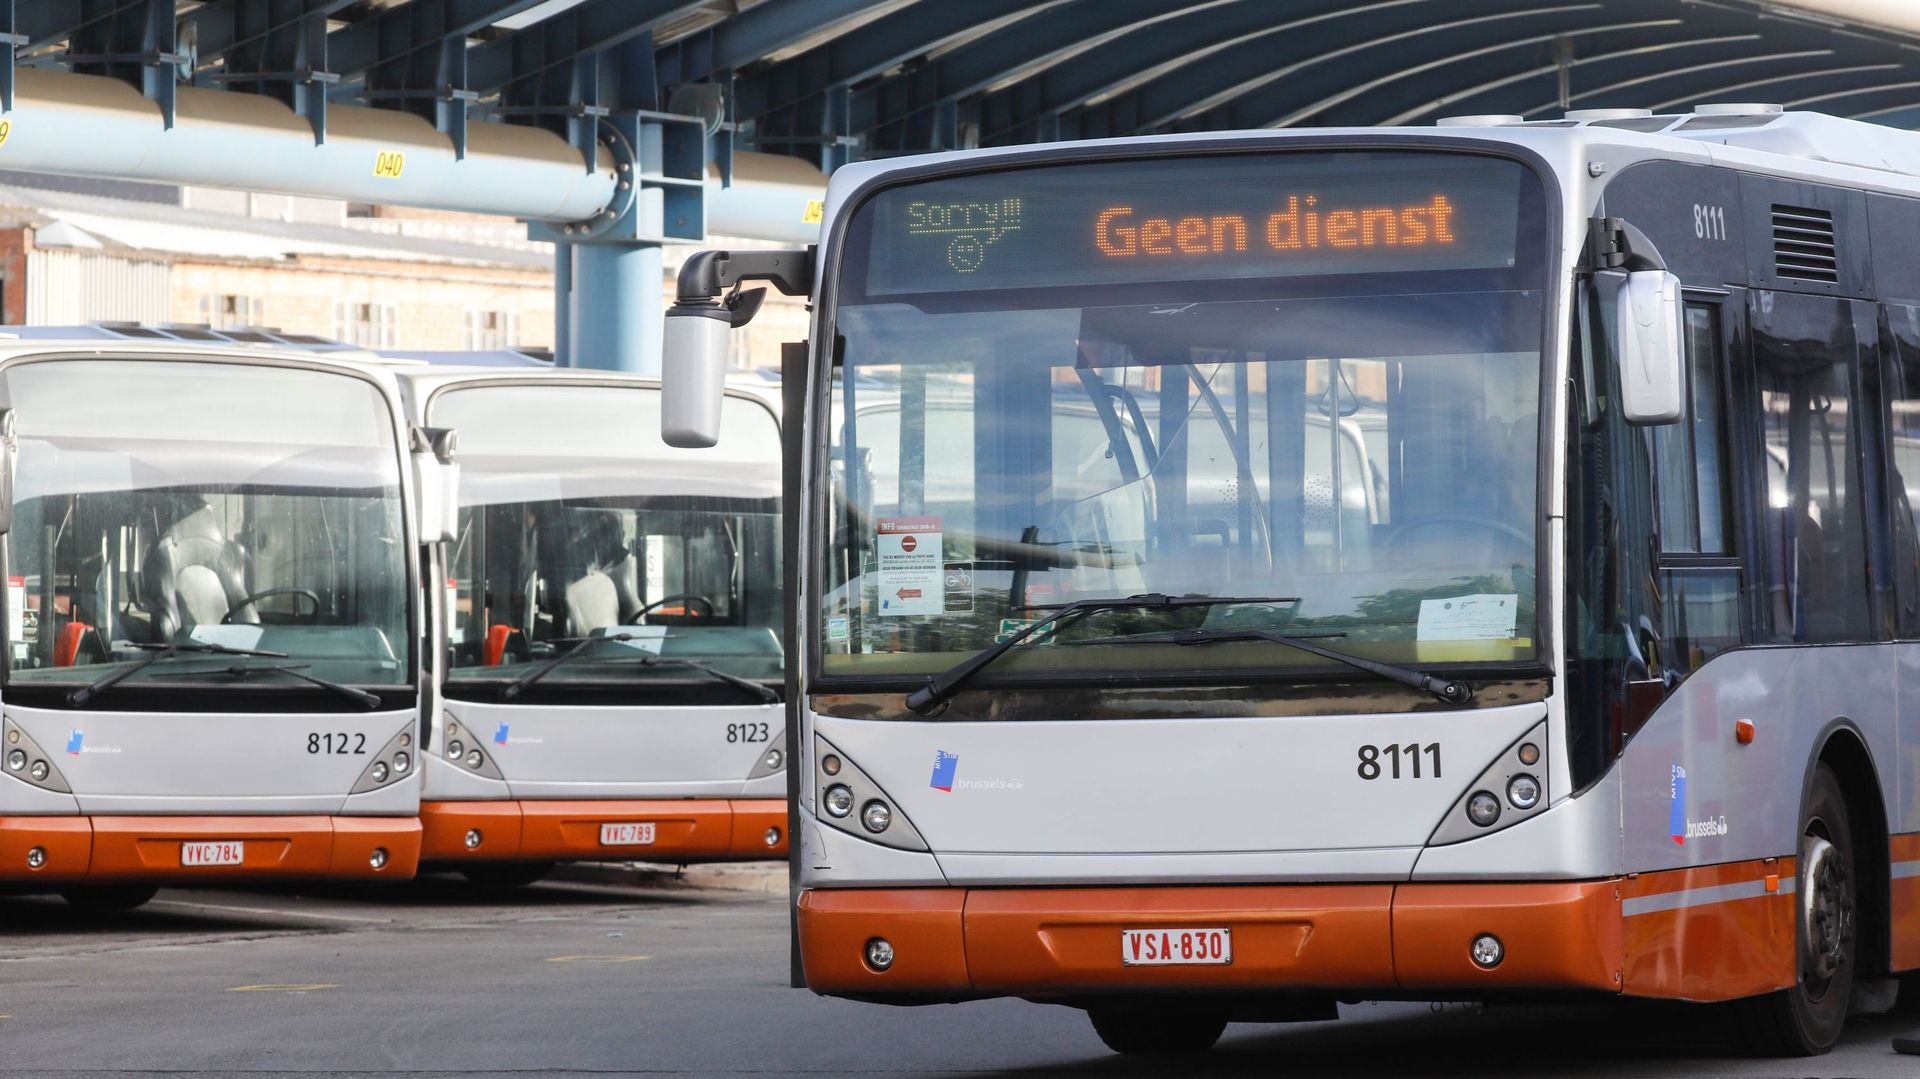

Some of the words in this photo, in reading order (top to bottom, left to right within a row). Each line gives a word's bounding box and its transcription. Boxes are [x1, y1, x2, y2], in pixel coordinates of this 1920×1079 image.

[909, 198, 1020, 227] Sorry!!!
[1096, 206, 1246, 256] Geen
[1267, 194, 1453, 249] dienst
[1693, 203, 1726, 241] 8111
[307, 732, 367, 755] 8122
[726, 722, 769, 743] 8123
[1357, 742, 1442, 780] 8111
